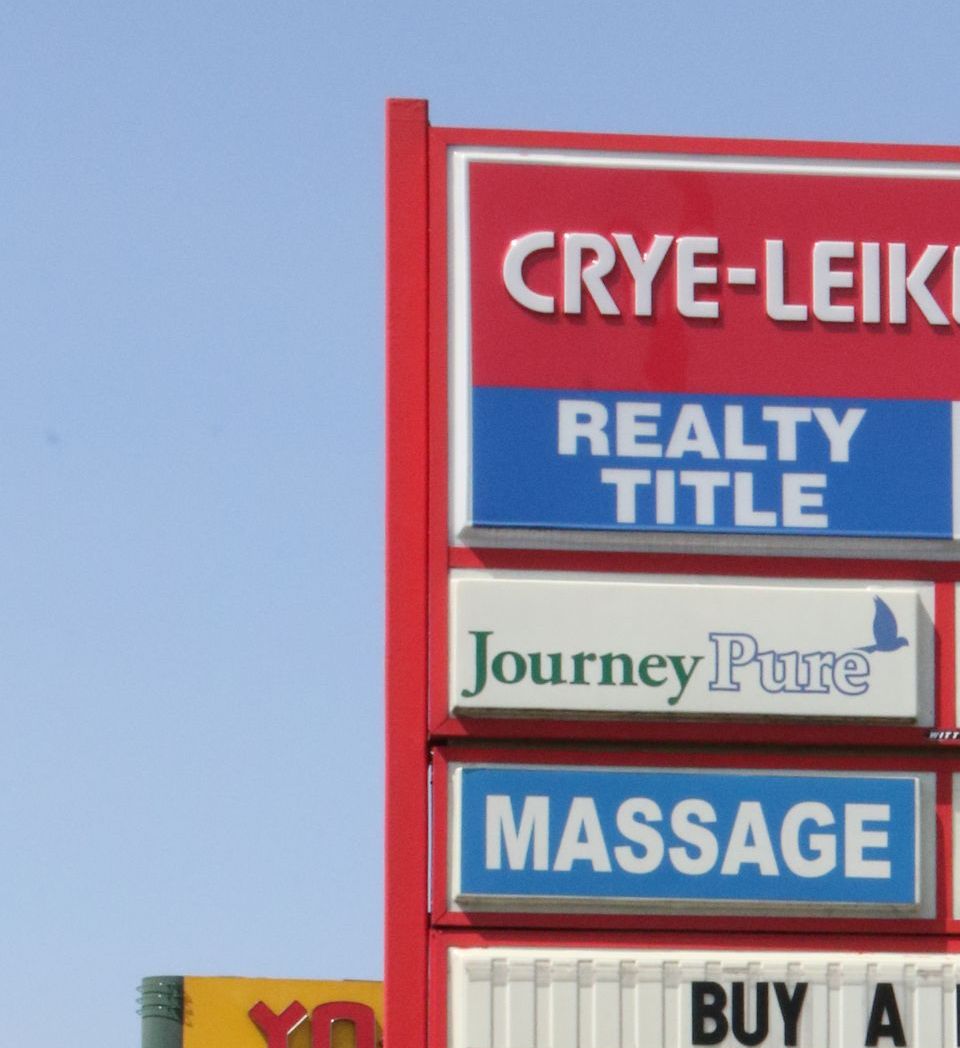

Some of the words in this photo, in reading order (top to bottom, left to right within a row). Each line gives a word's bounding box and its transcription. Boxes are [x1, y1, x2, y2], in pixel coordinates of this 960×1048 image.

[557, 400, 866, 462] REALTY
[602, 469, 827, 527] TITLE
[929, 731, 959, 739] WITT
[486, 796, 890, 878] MASSAGE
[692, 981, 808, 1047] BUY
[865, 983, 906, 1047] A
